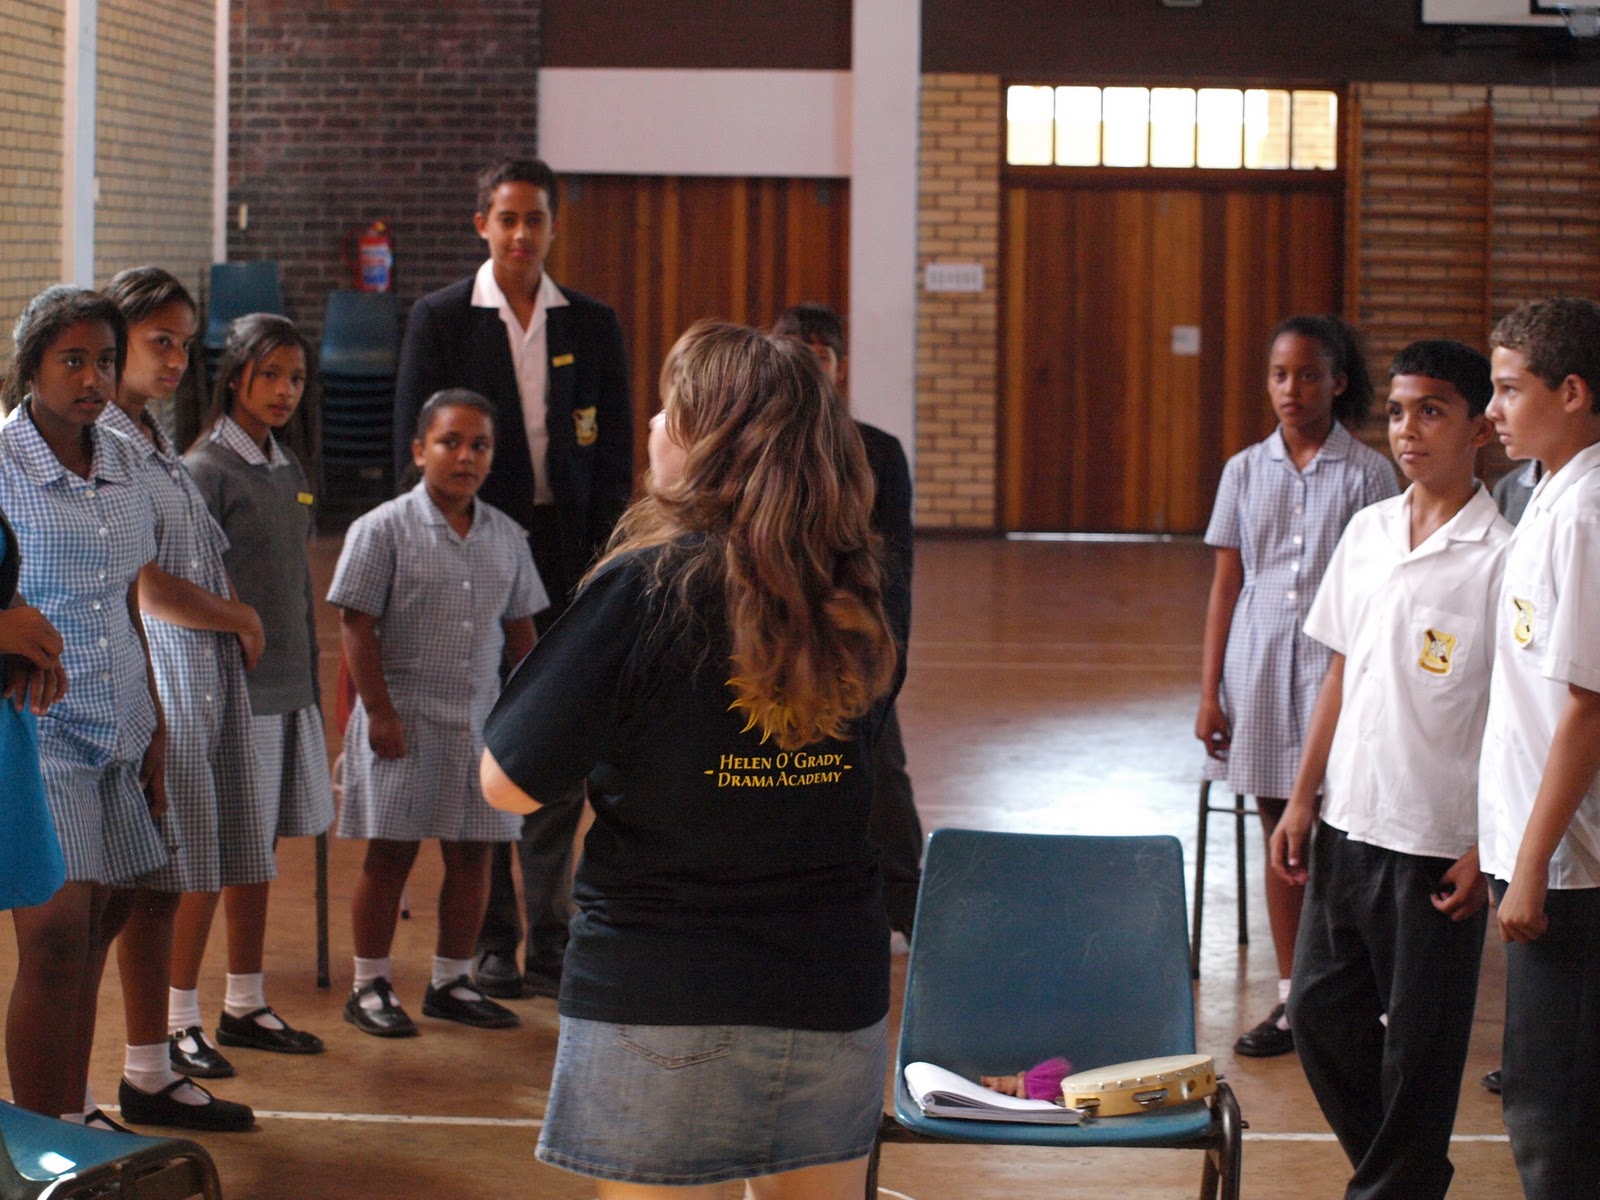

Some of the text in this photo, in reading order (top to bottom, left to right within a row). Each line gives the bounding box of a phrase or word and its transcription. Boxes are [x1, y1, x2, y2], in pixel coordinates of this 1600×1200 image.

[719, 754, 772, 770] HELEN
[718, 771, 842, 787] DRAMA ACADEMY
